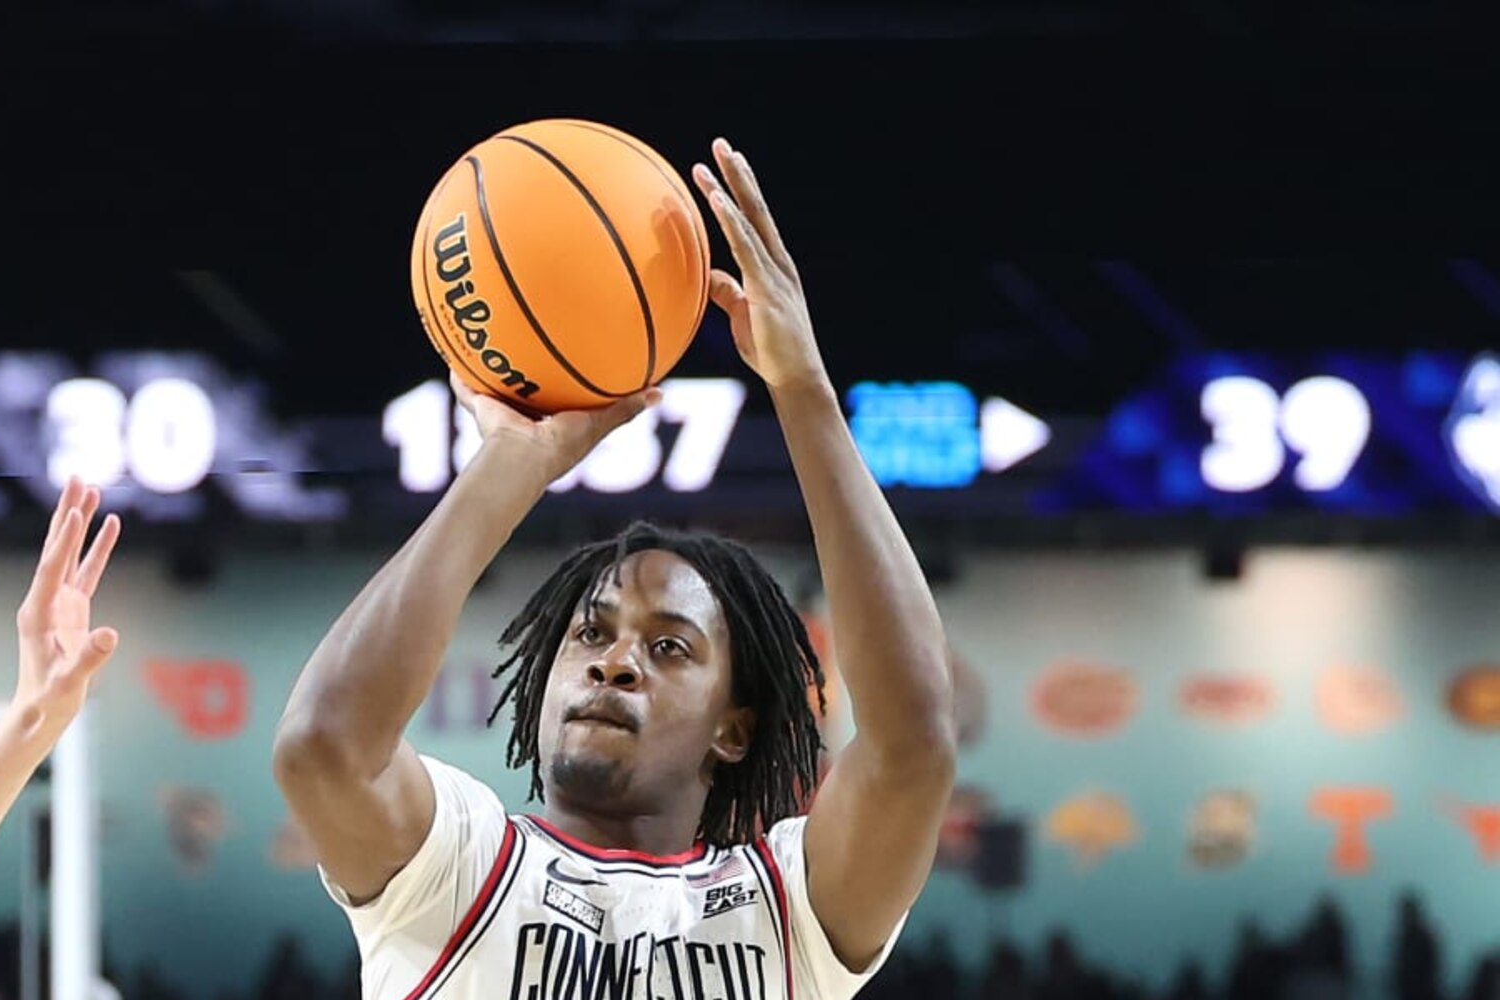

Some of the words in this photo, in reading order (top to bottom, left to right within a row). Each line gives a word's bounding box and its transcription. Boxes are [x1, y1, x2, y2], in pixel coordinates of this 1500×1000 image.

[433, 212, 541, 400] Wilson
[46, 378, 218, 493] 30
[1200, 375, 1370, 492] 39
[702, 889, 758, 914] EAST
[704, 881, 744, 901] BIG
